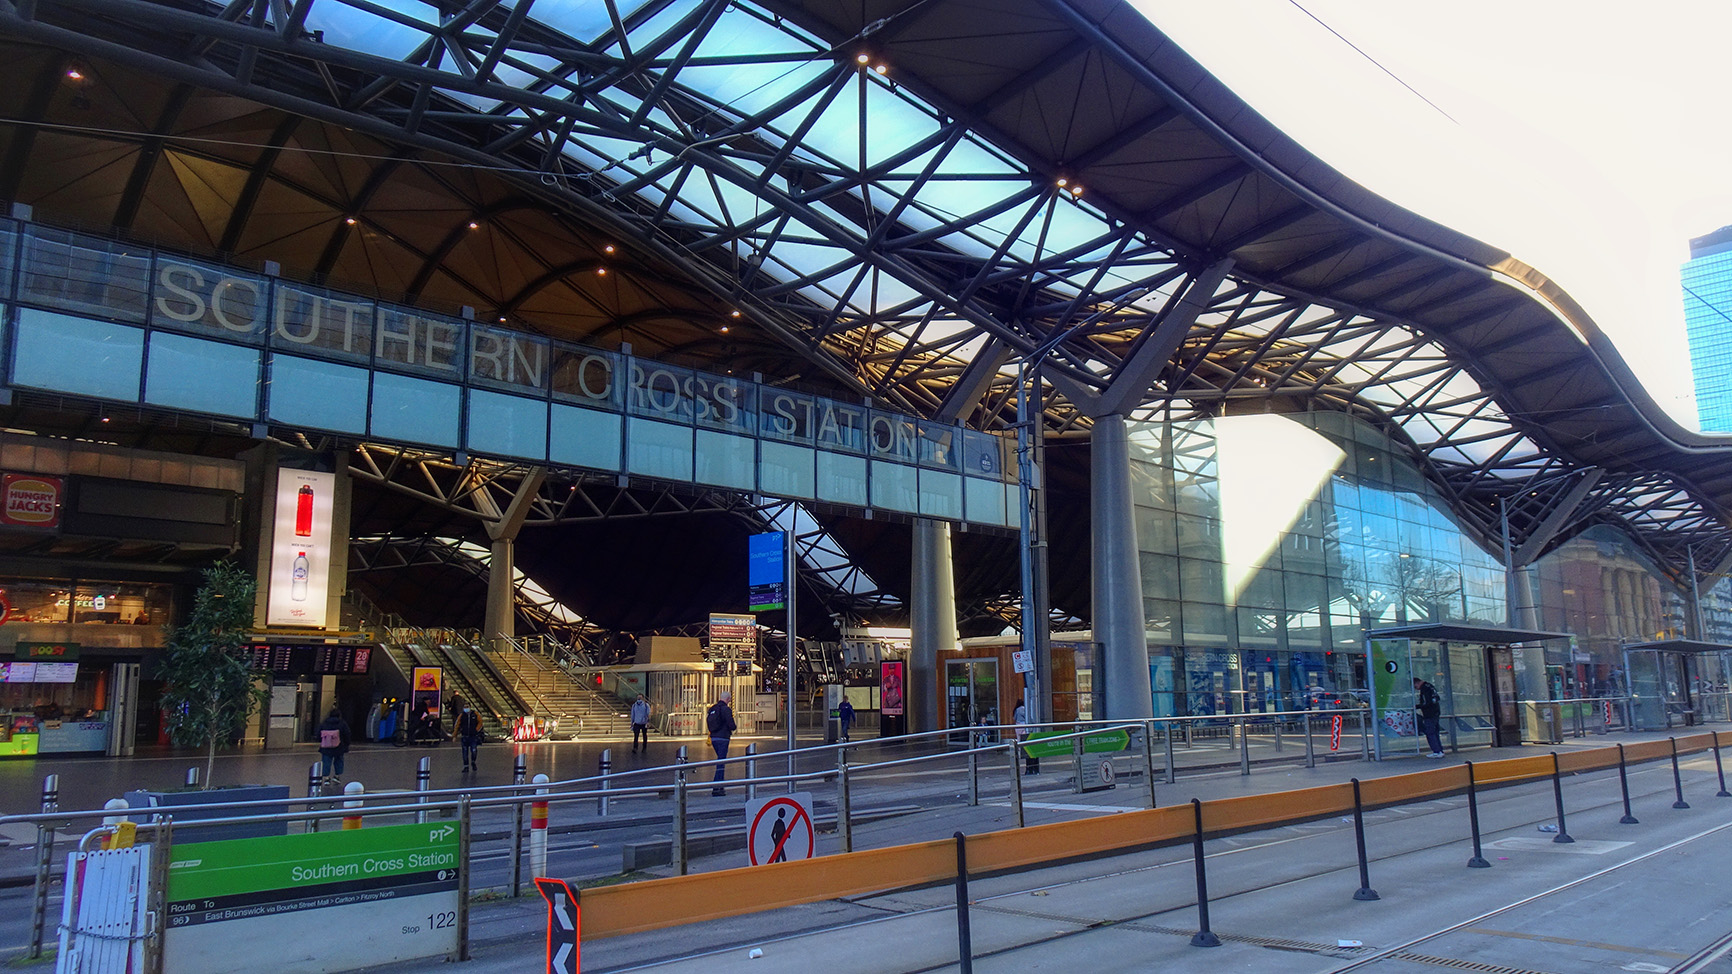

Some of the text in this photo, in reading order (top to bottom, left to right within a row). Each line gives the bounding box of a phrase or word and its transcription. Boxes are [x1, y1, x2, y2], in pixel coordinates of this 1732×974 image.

[155, 264, 917, 457] SOUTHERN CROSS STATON
[10, 490, 53, 501] HUNGRY
[58, 599, 94, 607] COFEE
[291, 852, 454, 882] Southern Cross Station
[170, 900, 215, 913] Route To
[172, 916, 184, 926] 96
[205, 910, 223, 921] East
[225, 907, 266, 919] Brunswick
[266, 904, 276, 912] via
[276, 903, 298, 912] Bourke
[299, 900, 316, 909] Street
[379, 890, 395, 899] North
[402, 911, 456, 936] Stop 122
